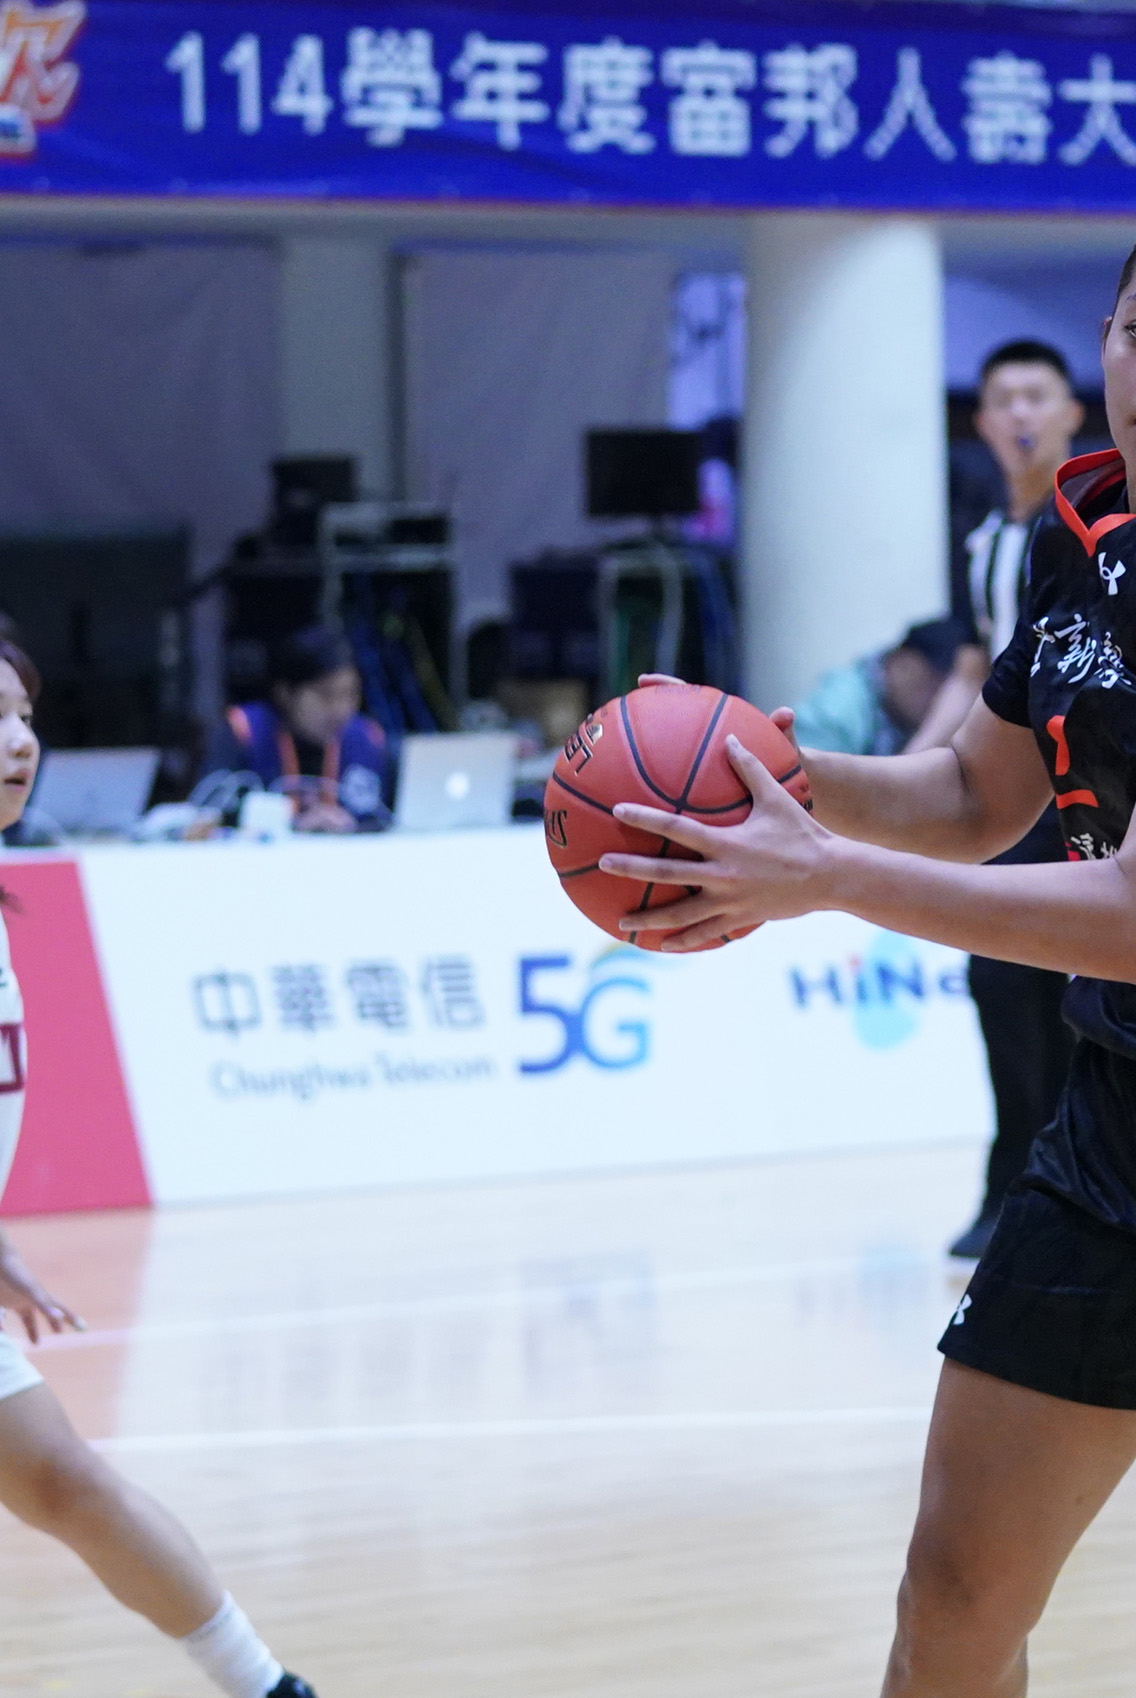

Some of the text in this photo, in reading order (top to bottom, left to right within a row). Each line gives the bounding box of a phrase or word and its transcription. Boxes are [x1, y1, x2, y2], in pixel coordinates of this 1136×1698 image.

[192, 955, 487, 1042] 中華電信
[517, 954, 652, 1074] 5G
